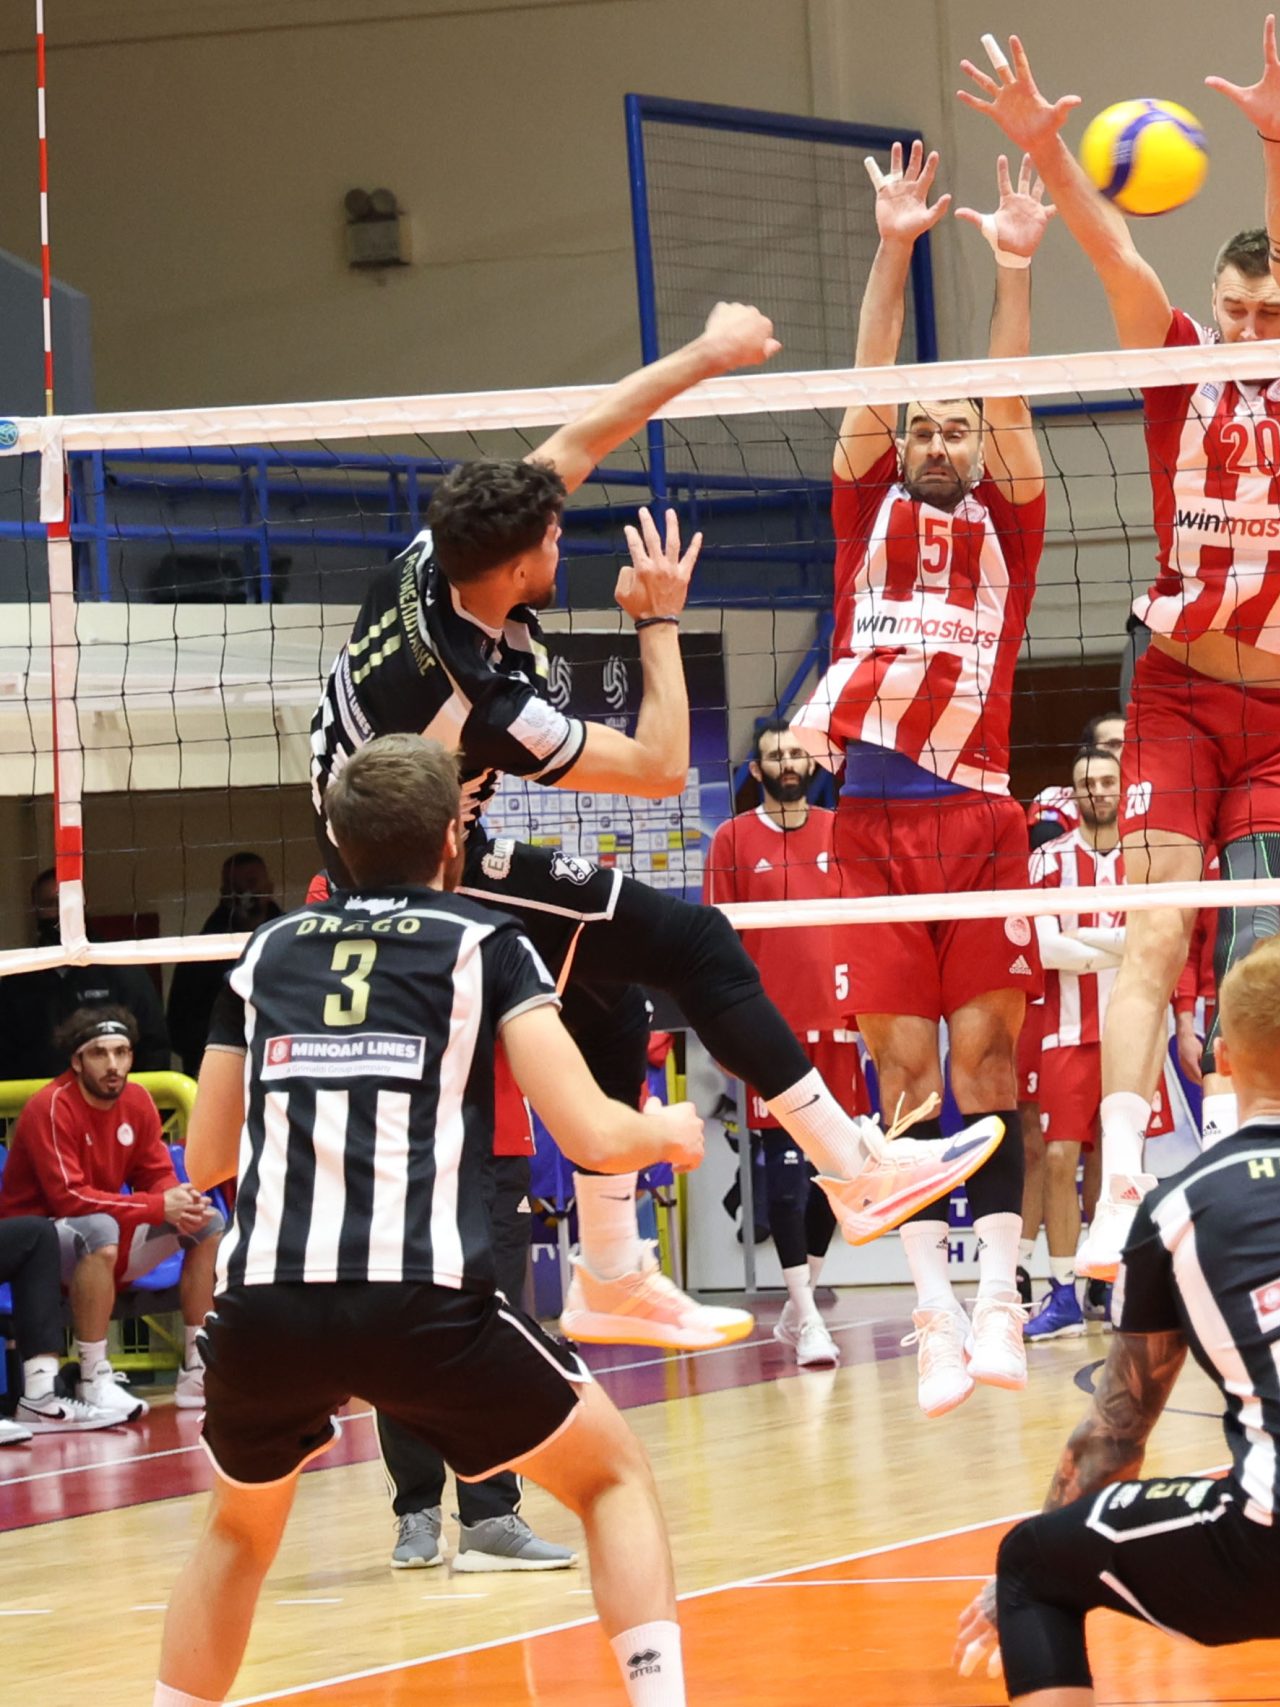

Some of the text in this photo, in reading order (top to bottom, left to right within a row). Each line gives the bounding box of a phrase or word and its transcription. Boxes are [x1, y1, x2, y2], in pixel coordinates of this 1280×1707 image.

[922, 518, 950, 574] 5
[857, 612, 997, 650] winmasters
[1125, 781, 1153, 820] 20
[296, 918, 421, 935] DRAGO
[323, 939, 377, 1027] 3
[835, 963, 849, 1000] 5
[291, 1041, 416, 1058] MINOAN LINES
